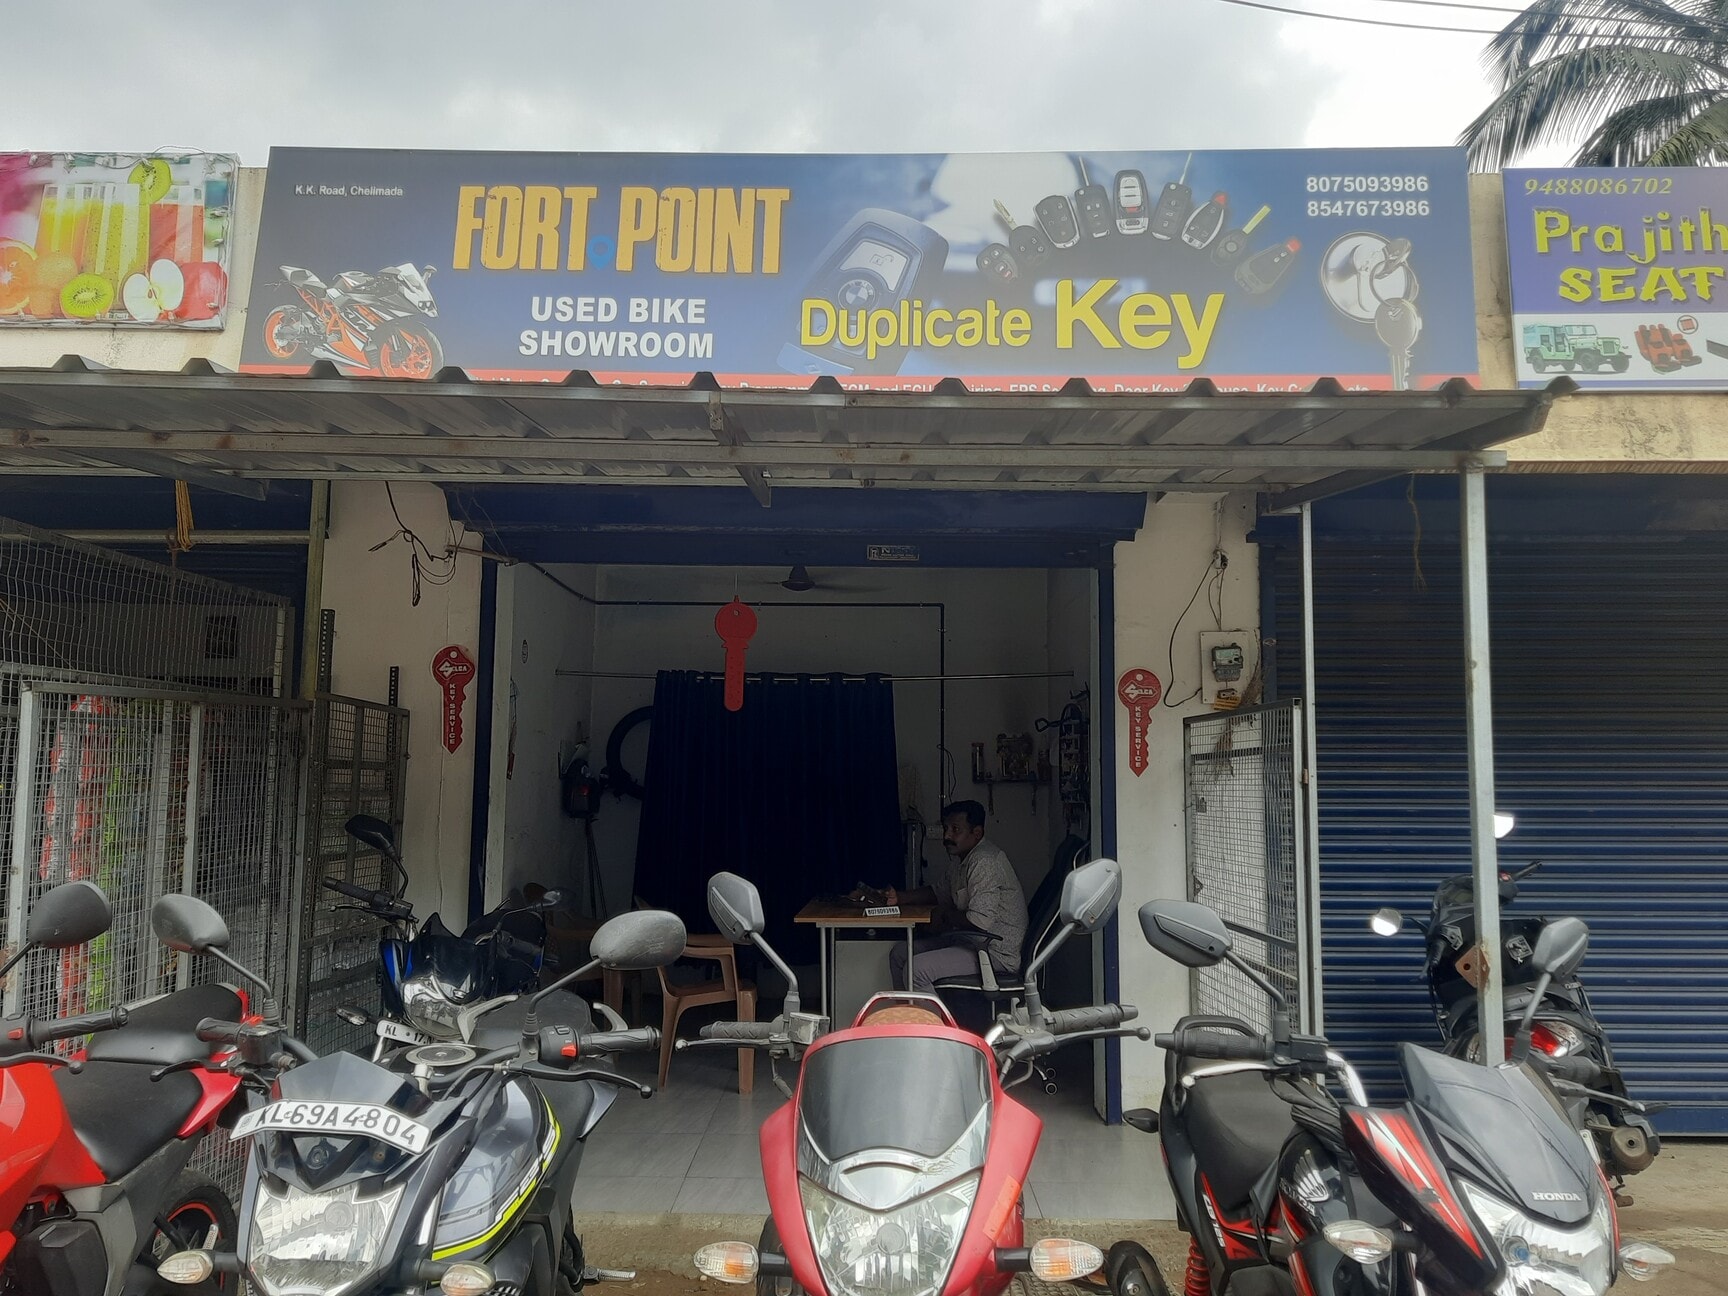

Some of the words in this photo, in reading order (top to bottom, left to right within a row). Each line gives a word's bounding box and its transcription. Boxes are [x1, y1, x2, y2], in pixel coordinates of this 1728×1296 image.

[295, 185, 316, 195] K.K.
[319, 186, 347, 197] Road,
[1306, 176, 1429, 192] 8075093986
[1524, 178, 1673, 196] 9488086702
[1307, 200, 1430, 217] 8547673986
[452, 185, 598, 271] FORT
[615, 186, 791, 274] POINT
[1559, 267, 1724, 302] SEAT
[531, 296, 618, 323] USED
[628, 297, 705, 323] BIKE
[800, 298, 1032, 359] Duplicate
[1056, 279, 1225, 370] Key
[518, 329, 712, 358] SHOWROOM
[385, 1024, 397, 1036] KL
[1531, 1192, 1581, 1201] HONDA
